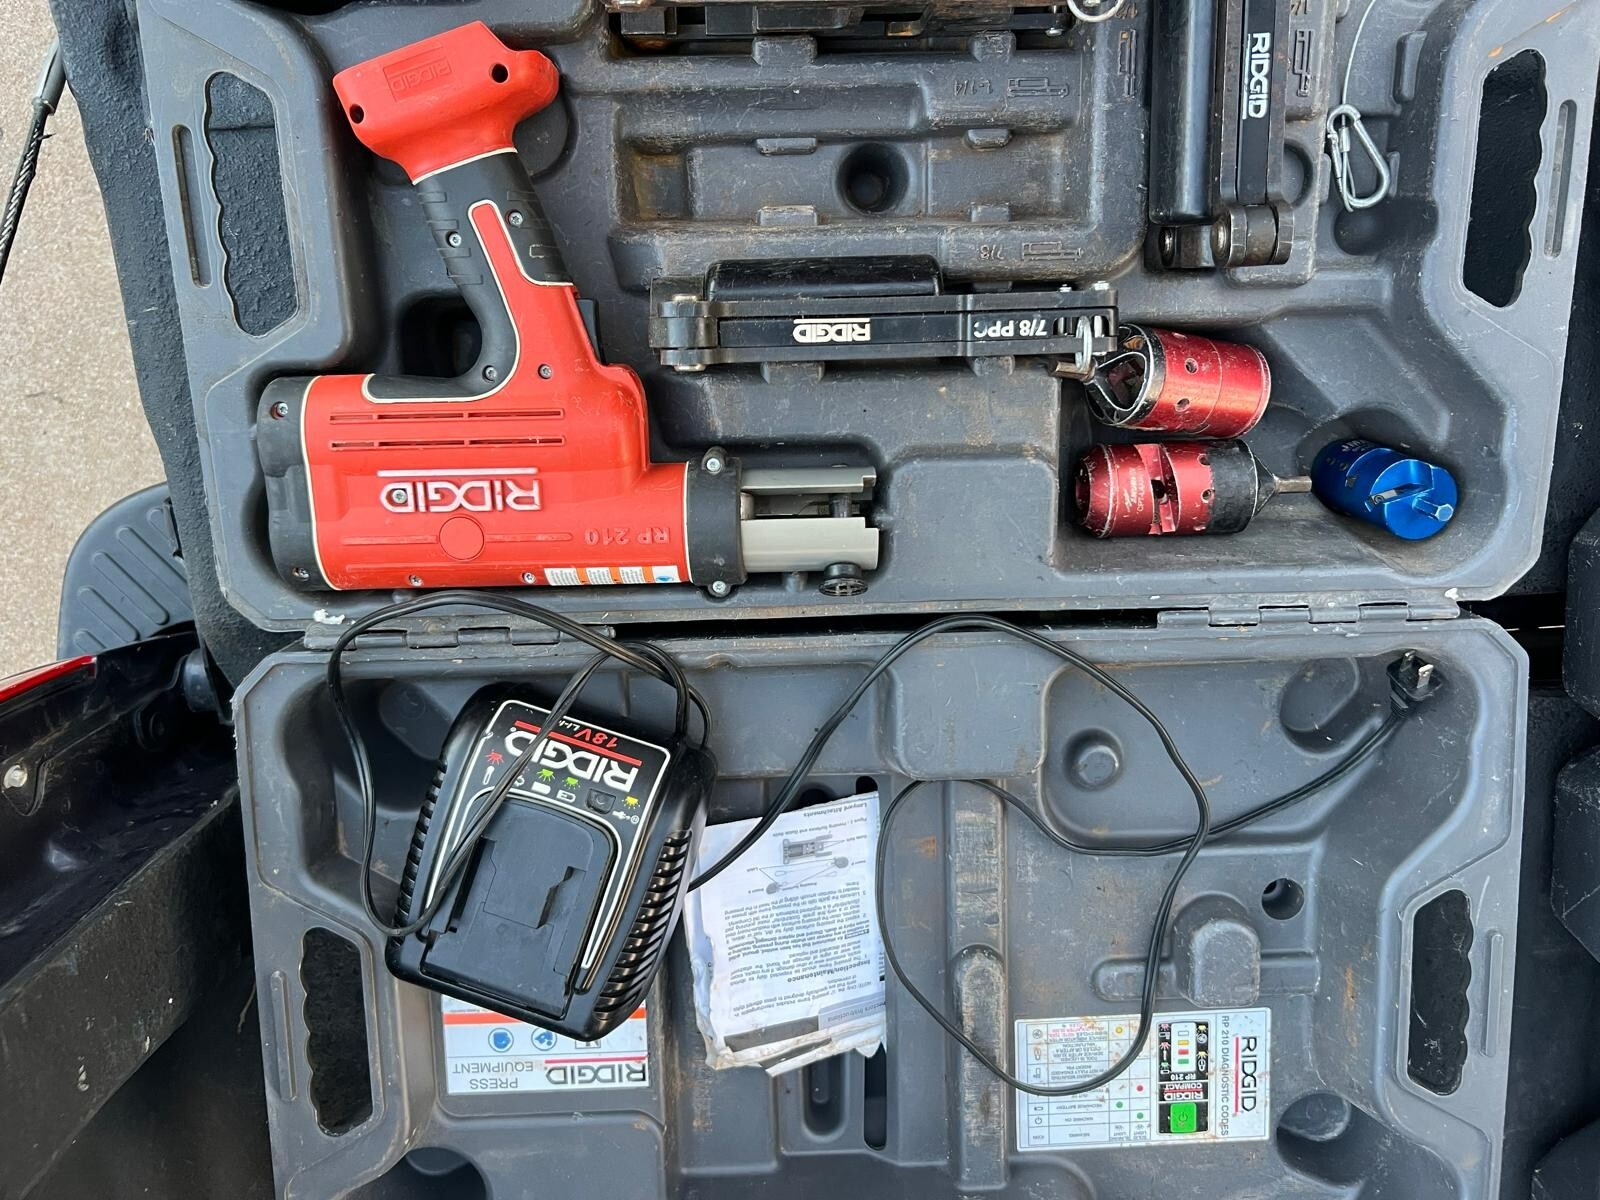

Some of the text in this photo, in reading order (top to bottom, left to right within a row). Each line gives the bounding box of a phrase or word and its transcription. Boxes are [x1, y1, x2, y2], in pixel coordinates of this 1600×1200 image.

[391, 60, 452, 90] RIDGID
[1247, 32, 1270, 118] RIDGID
[792, 322, 870, 342] RIDGID
[973, 319, 1046, 337] 7/8 PPC
[379, 479, 540, 512] RIDGID
[584, 527, 669, 544] RP 210
[574, 728, 618, 748] 18V
[504, 729, 640, 793] RIDGID
[1221, 1015, 1229, 1027] RP
[452, 1061, 533, 1073] EQUIPMENT
[545, 1063, 646, 1085] RIDGID
[1219, 1047, 1230, 1102] DIAGNOSTIC
[1241, 1036, 1256, 1111] RIDGID
[470, 1078, 518, 1089] PRESS
[1163, 1091, 1203, 1100] RIDGID
[1220, 1105, 1229, 1135] CODES
